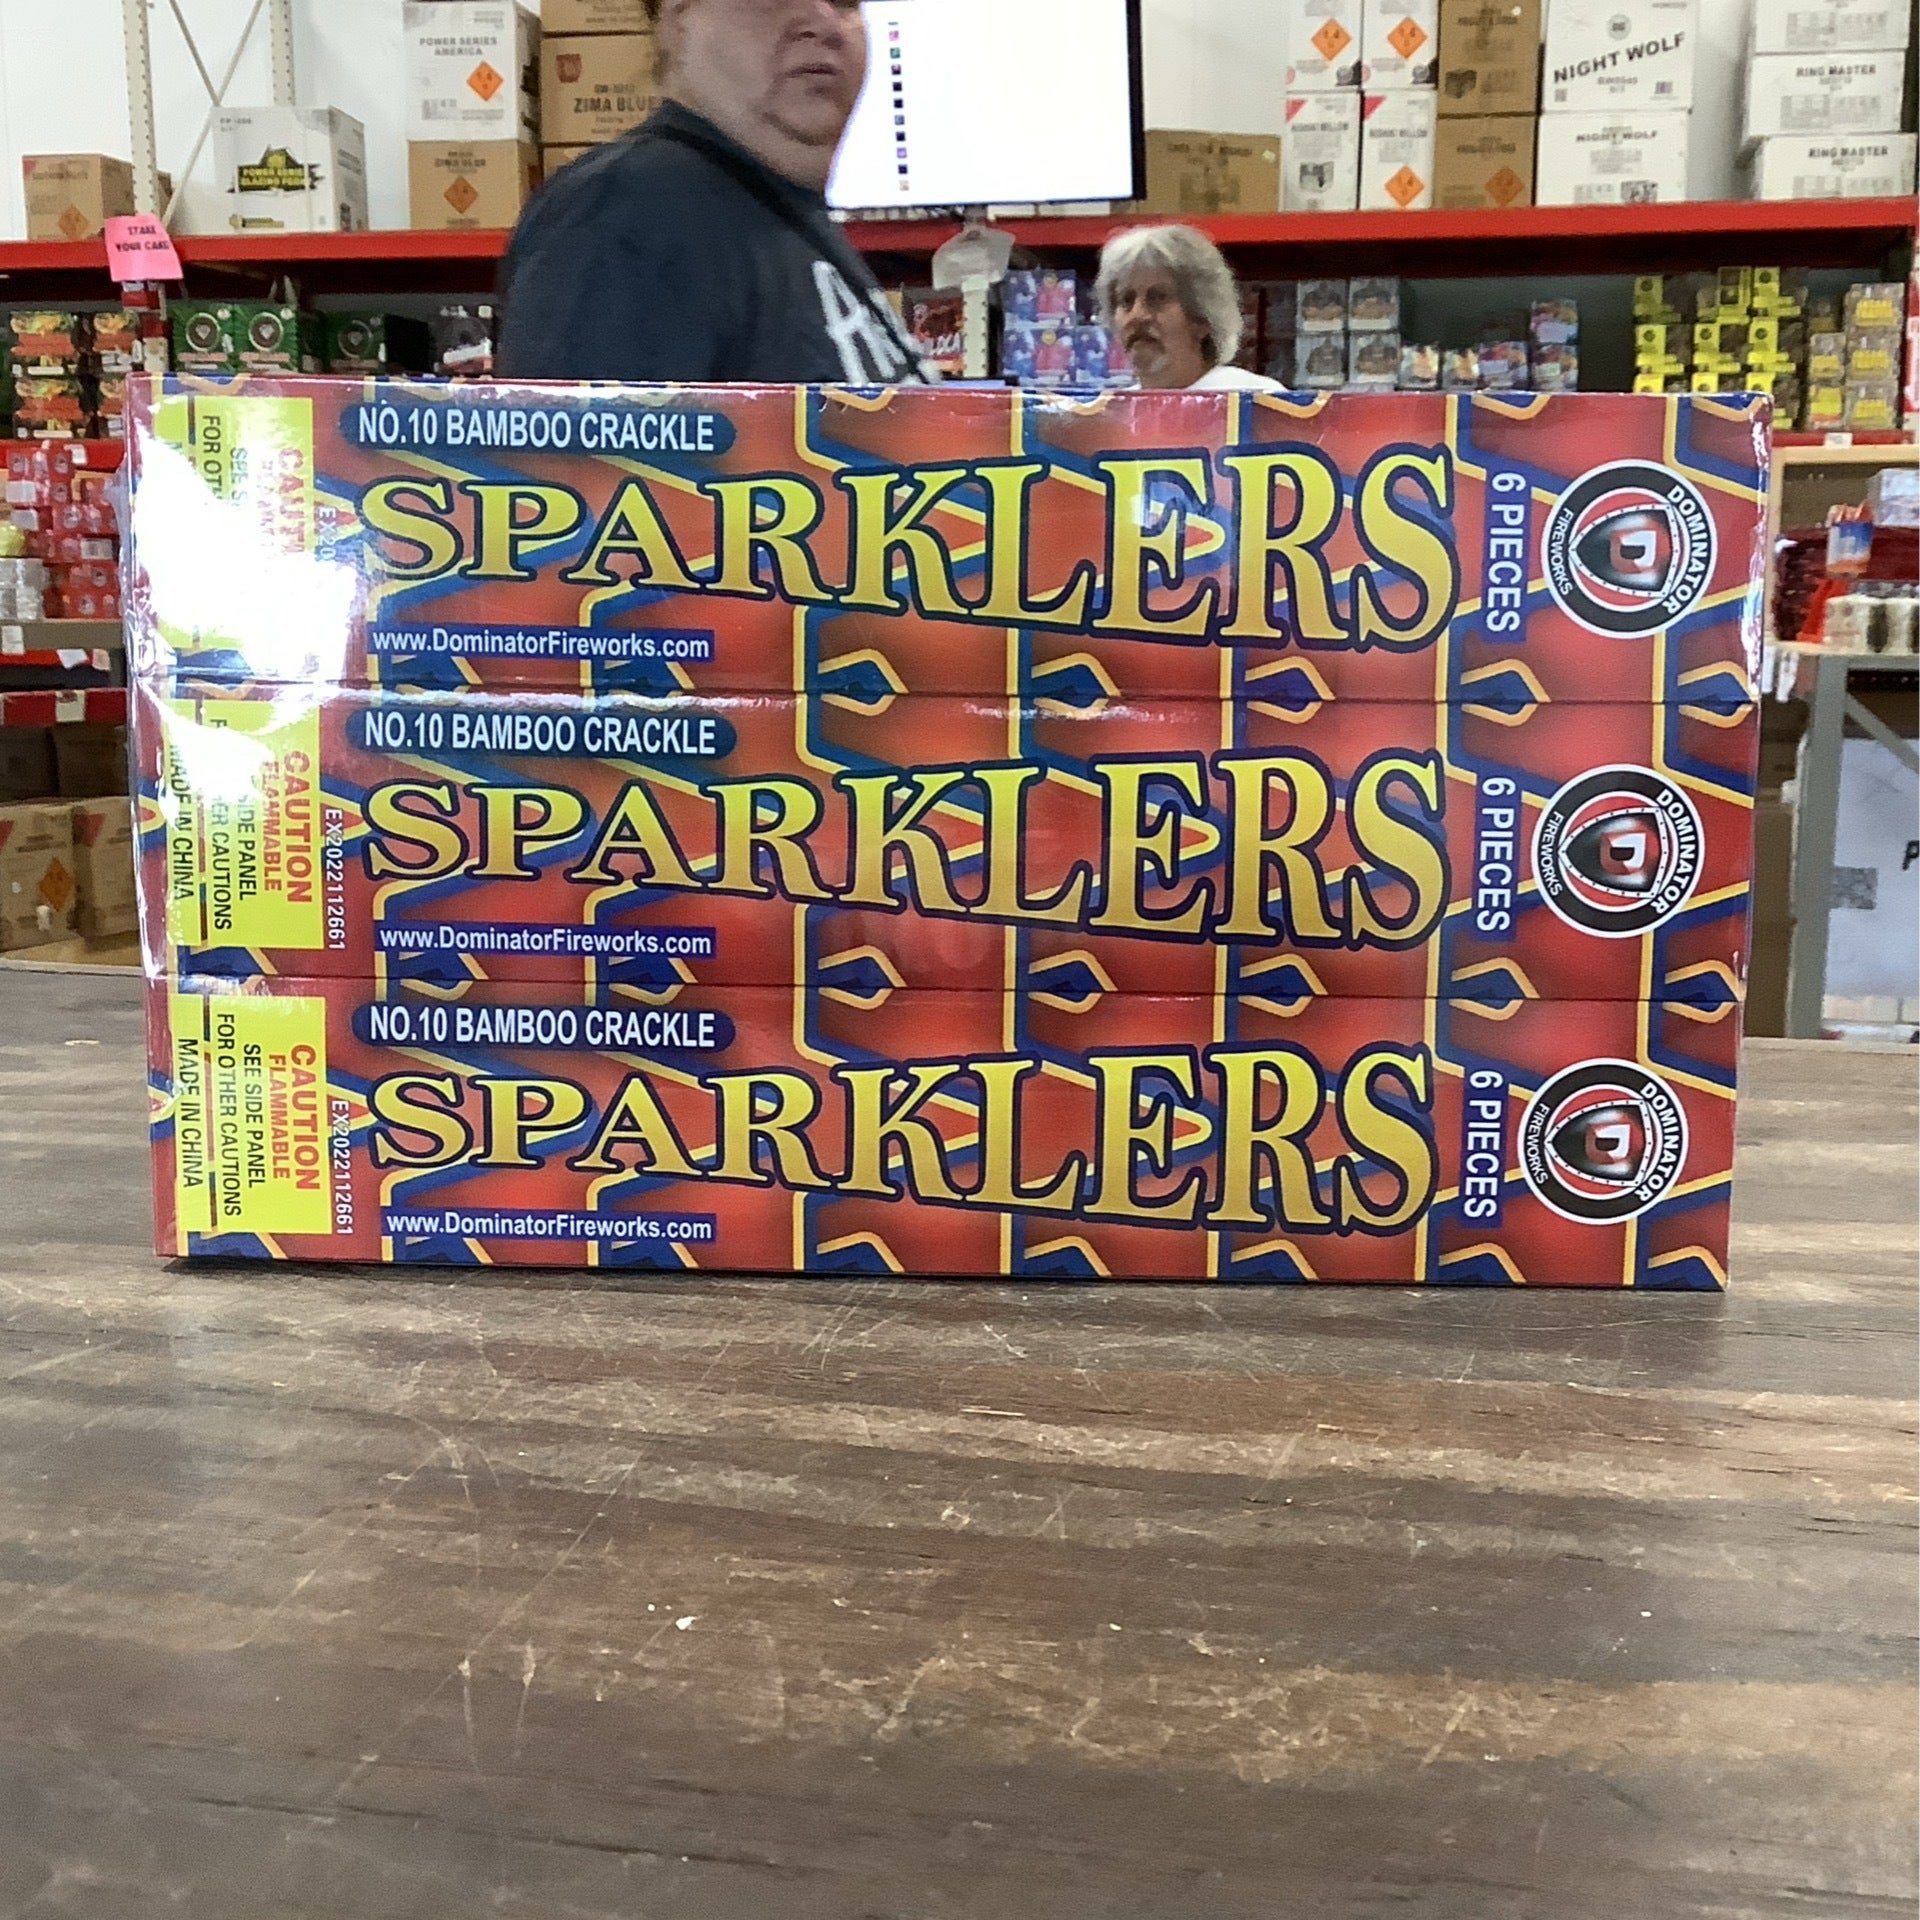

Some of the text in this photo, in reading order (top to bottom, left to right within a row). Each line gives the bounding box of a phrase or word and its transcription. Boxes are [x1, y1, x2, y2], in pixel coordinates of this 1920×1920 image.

[459, 36, 498, 46] SERIES
[1553, 32, 1685, 84] NIGHT WOLF
[1828, 65, 1876, 75] MASTER
[574, 97, 612, 113] ZIMA
[1840, 146, 1888, 156] MASTER
[202, 415, 222, 453] FOR
[358, 407, 715, 452] NO.10 BAMBOO CRACKLE
[357, 442, 1462, 652] SPARKLERS
[1486, 471, 1527, 633] 6 PIECES
[1550, 507, 1574, 596] FIREWORKS
[1661, 484, 1708, 615] DOMINATOR
[372, 628, 711, 658] www.DominatorFireworks.com
[365, 711, 716, 755] NO.10 BAMBOO CRACKLE
[172, 837, 195, 901] CHINA
[238, 839, 257, 901] PANEL
[284, 750, 313, 903] CAUTION
[360, 745, 1452, 952] SPARKLERS
[1476, 776, 1516, 932] 6 PIECES
[1540, 810, 1564, 897] FIREWORKS
[1650, 788, 1699, 915] DOMINATOR
[212, 831, 232, 930] CAUTIONS
[325, 808, 346, 950] EX2022112661
[379, 925, 712, 954] www.DominatorFireworks.com
[370, 1005, 716, 1048] NO.10 BAMBOO CRACKLE
[178, 1038, 204, 1188] MADE IN CHINA
[217, 1013, 242, 1217] FOR OTHER CAUTIONS
[243, 1043, 266, 1189] SEE SIDE PANEL
[268, 1054, 290, 1179] FLAMMABLE
[290, 1044, 321, 1191] CAUTION
[367, 1039, 1440, 1238] SPARKLERS
[1463, 1070, 1504, 1219] 6 PIECES
[1526, 1103, 1550, 1185] FIREWORKS
[1634, 1082, 1681, 1202] DOMINATOR
[331, 1100, 354, 1235] EX2022112661
[386, 1211, 713, 1240] www.DominatorFireworks.com
